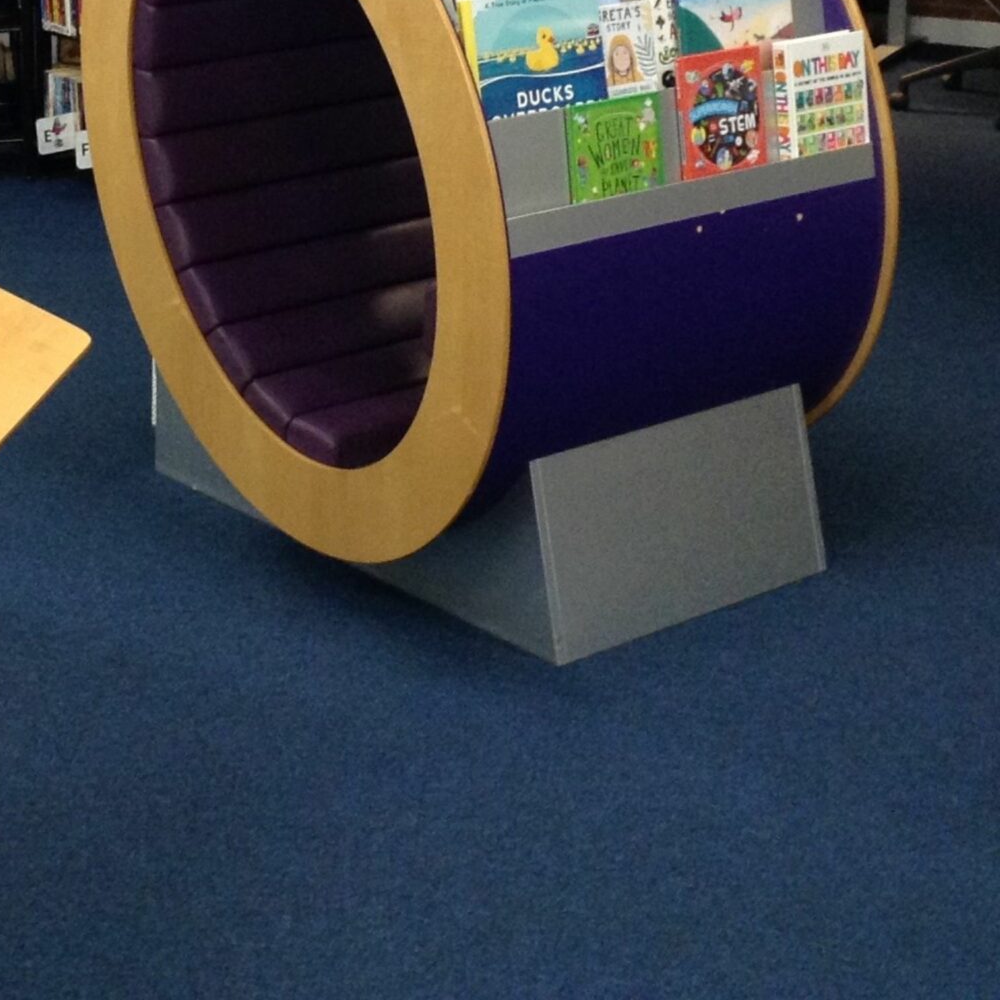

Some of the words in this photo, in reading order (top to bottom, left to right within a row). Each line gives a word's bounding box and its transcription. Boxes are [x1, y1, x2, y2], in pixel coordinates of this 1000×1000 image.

[606, 21, 631, 32] STORY
[838, 50, 860, 70] DAY
[516, 84, 575, 108] DUCKS
[595, 116, 634, 142] GREAT
[718, 113, 757, 136] STEM
[44, 129, 52, 143] E
[81, 142, 89, 157] F
[588, 134, 641, 168] WOMEN
